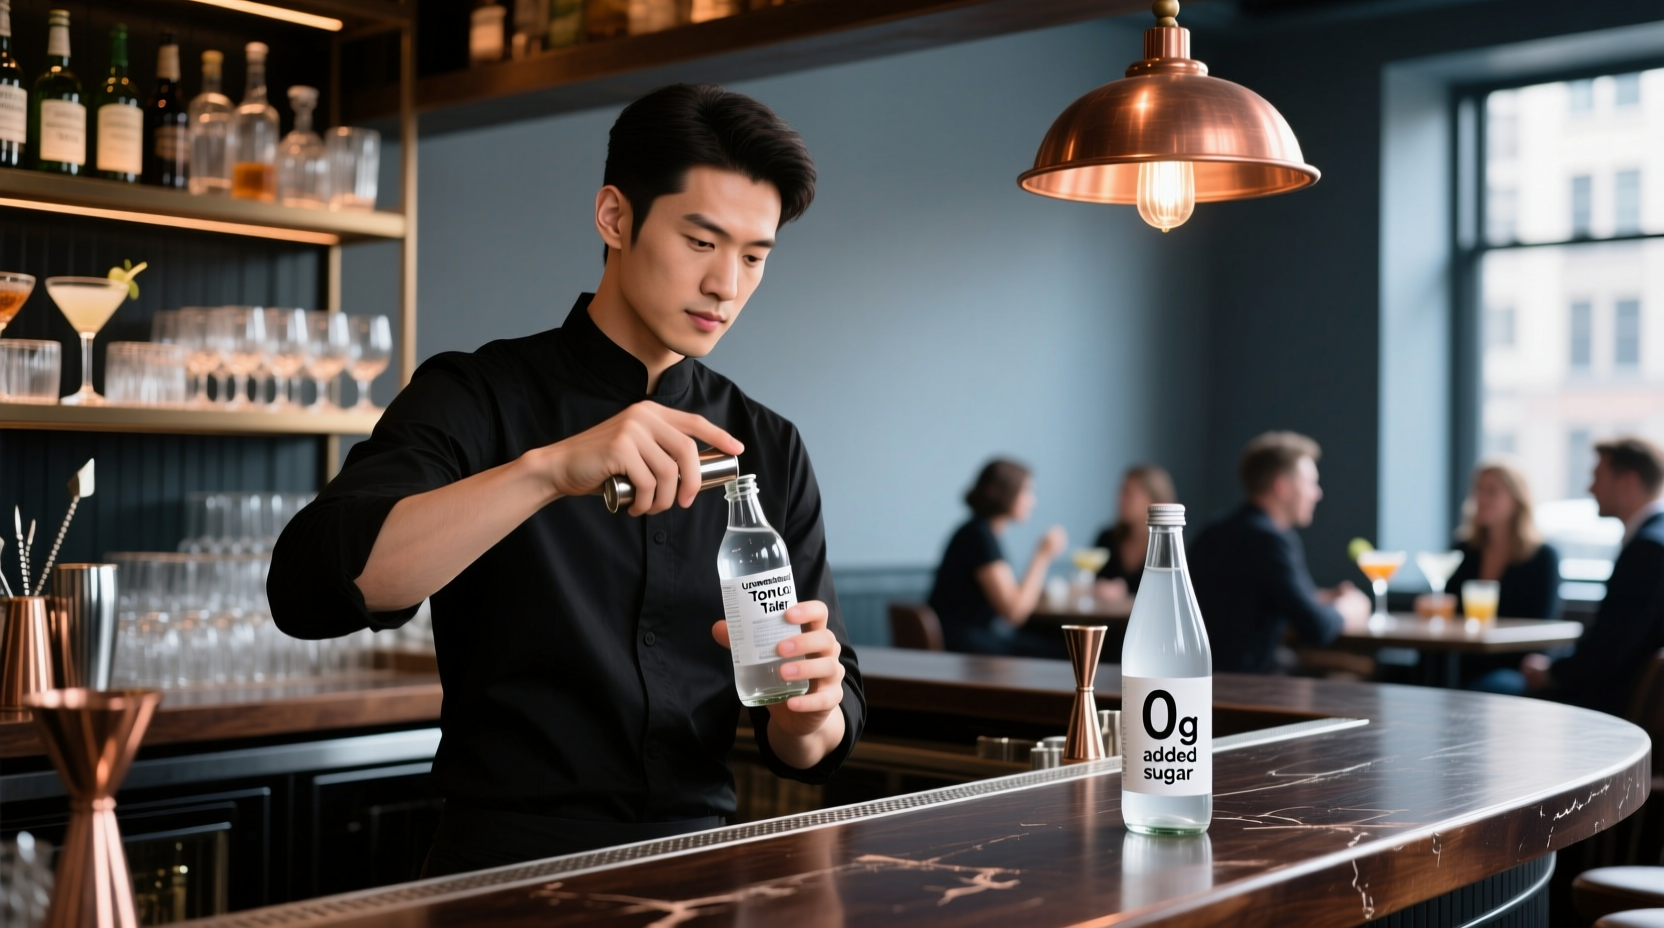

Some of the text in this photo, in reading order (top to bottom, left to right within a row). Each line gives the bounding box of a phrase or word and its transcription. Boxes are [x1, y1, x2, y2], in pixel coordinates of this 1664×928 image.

[1143, 689, 1198, 746] 0g
[1143, 746, 1197, 763] added
[1143, 767, 1194, 785] sugar
